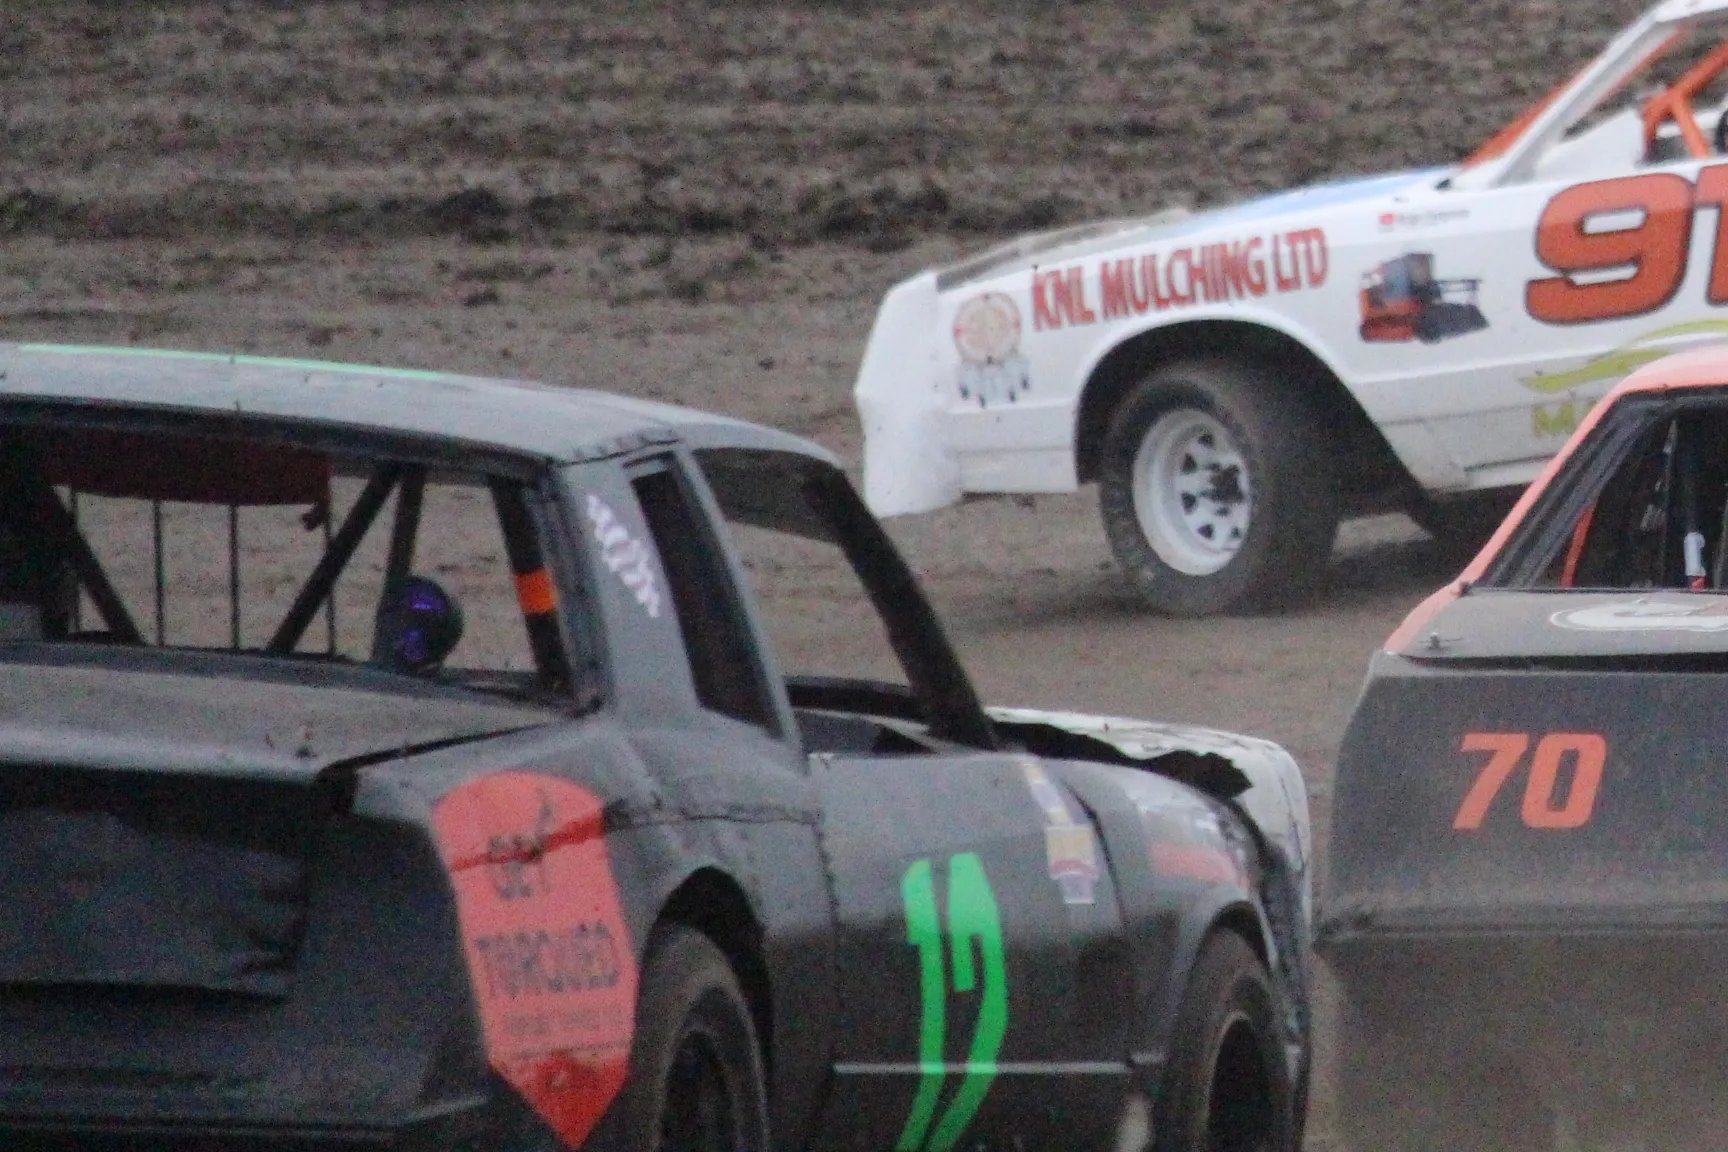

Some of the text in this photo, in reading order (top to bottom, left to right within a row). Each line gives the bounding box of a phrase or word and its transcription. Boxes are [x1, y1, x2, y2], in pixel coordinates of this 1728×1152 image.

[1098, 235, 1268, 322] MULCHING
[1272, 226, 1329, 293] LTD
[1452, 731, 1607, 830] 70
